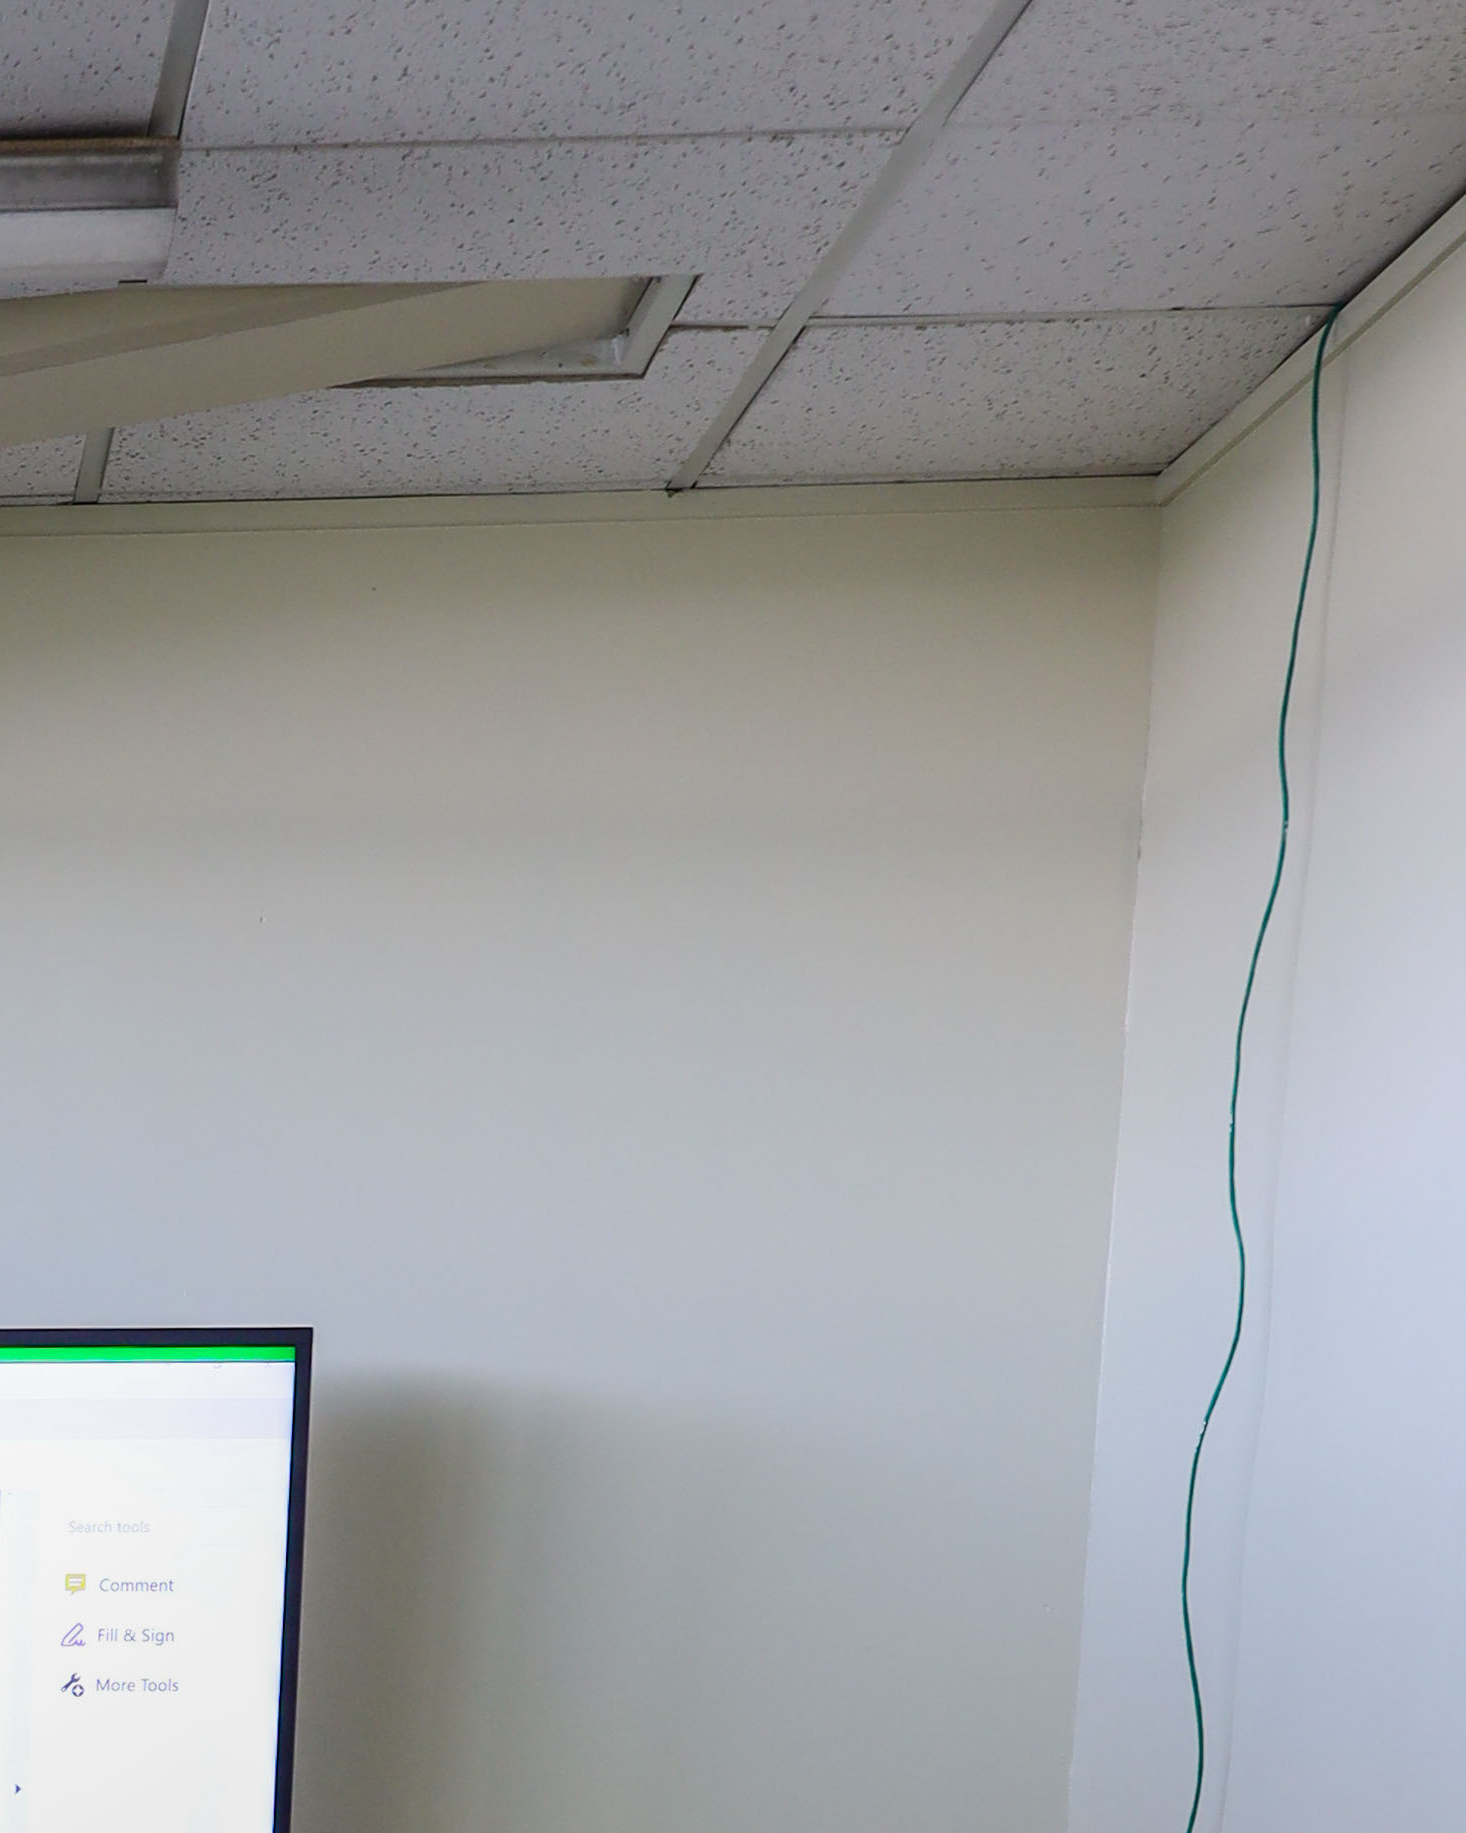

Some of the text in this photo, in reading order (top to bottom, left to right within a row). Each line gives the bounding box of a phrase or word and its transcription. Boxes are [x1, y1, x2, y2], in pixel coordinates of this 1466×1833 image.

[69, 1520, 150, 1533] Search tools
[99, 1578, 173, 1592] Comment
[98, 1628, 174, 1646] Fill & Sign
[96, 1678, 179, 1692] More Tools
